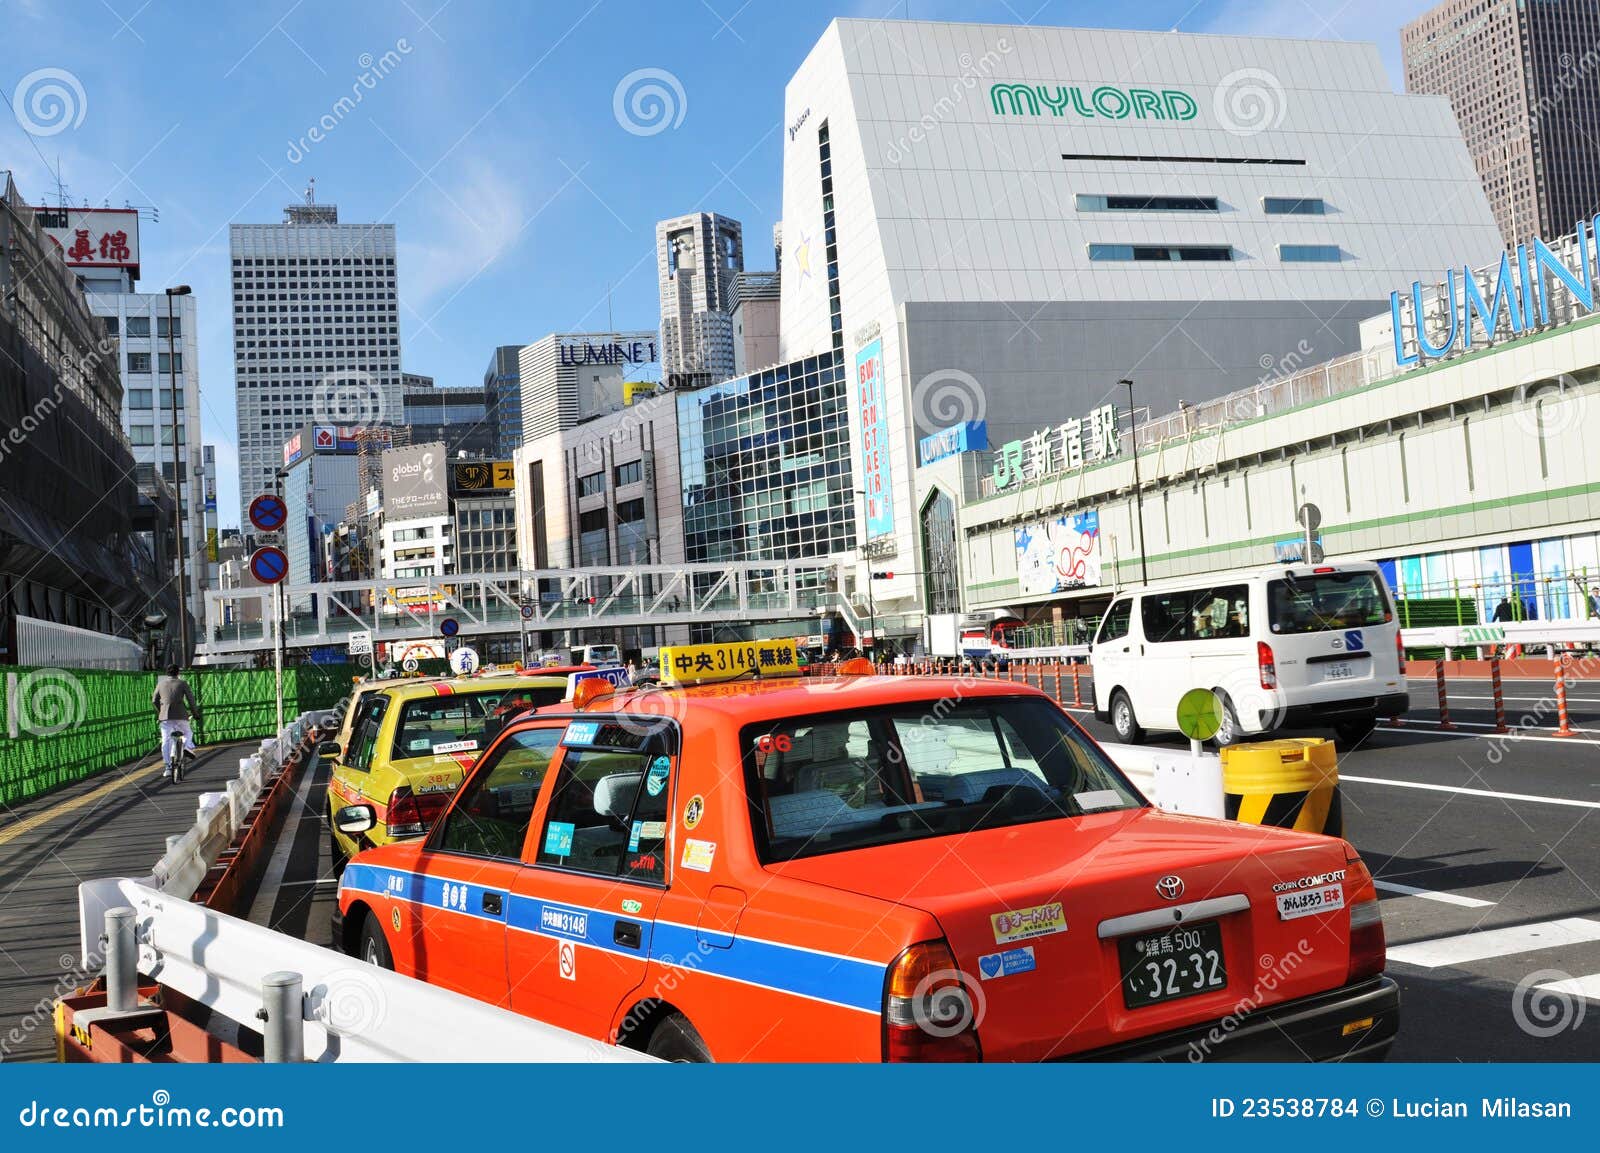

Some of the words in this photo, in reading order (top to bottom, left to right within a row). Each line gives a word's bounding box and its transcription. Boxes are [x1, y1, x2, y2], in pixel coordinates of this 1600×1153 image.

[989, 83, 1198, 121] MYLORD
[560, 342, 642, 365] LUMINE
[865, 357, 881, 493] WINTER
[859, 364, 876, 518] BARGAIN
[392, 463, 421, 482] global
[459, 650, 473, 671] 大和
[1272, 880, 1297, 893] CROWN
[1297, 869, 1347, 888] COMFORT
[1283, 892, 1322, 911] がんばろう
[1323, 888, 1341, 903] 日本
[1011, 903, 1062, 927] オートバイ
[1145, 935, 1174, 957] 練馬
[1175, 930, 1201, 951] 500
[1145, 949, 1222, 998] 32-32
